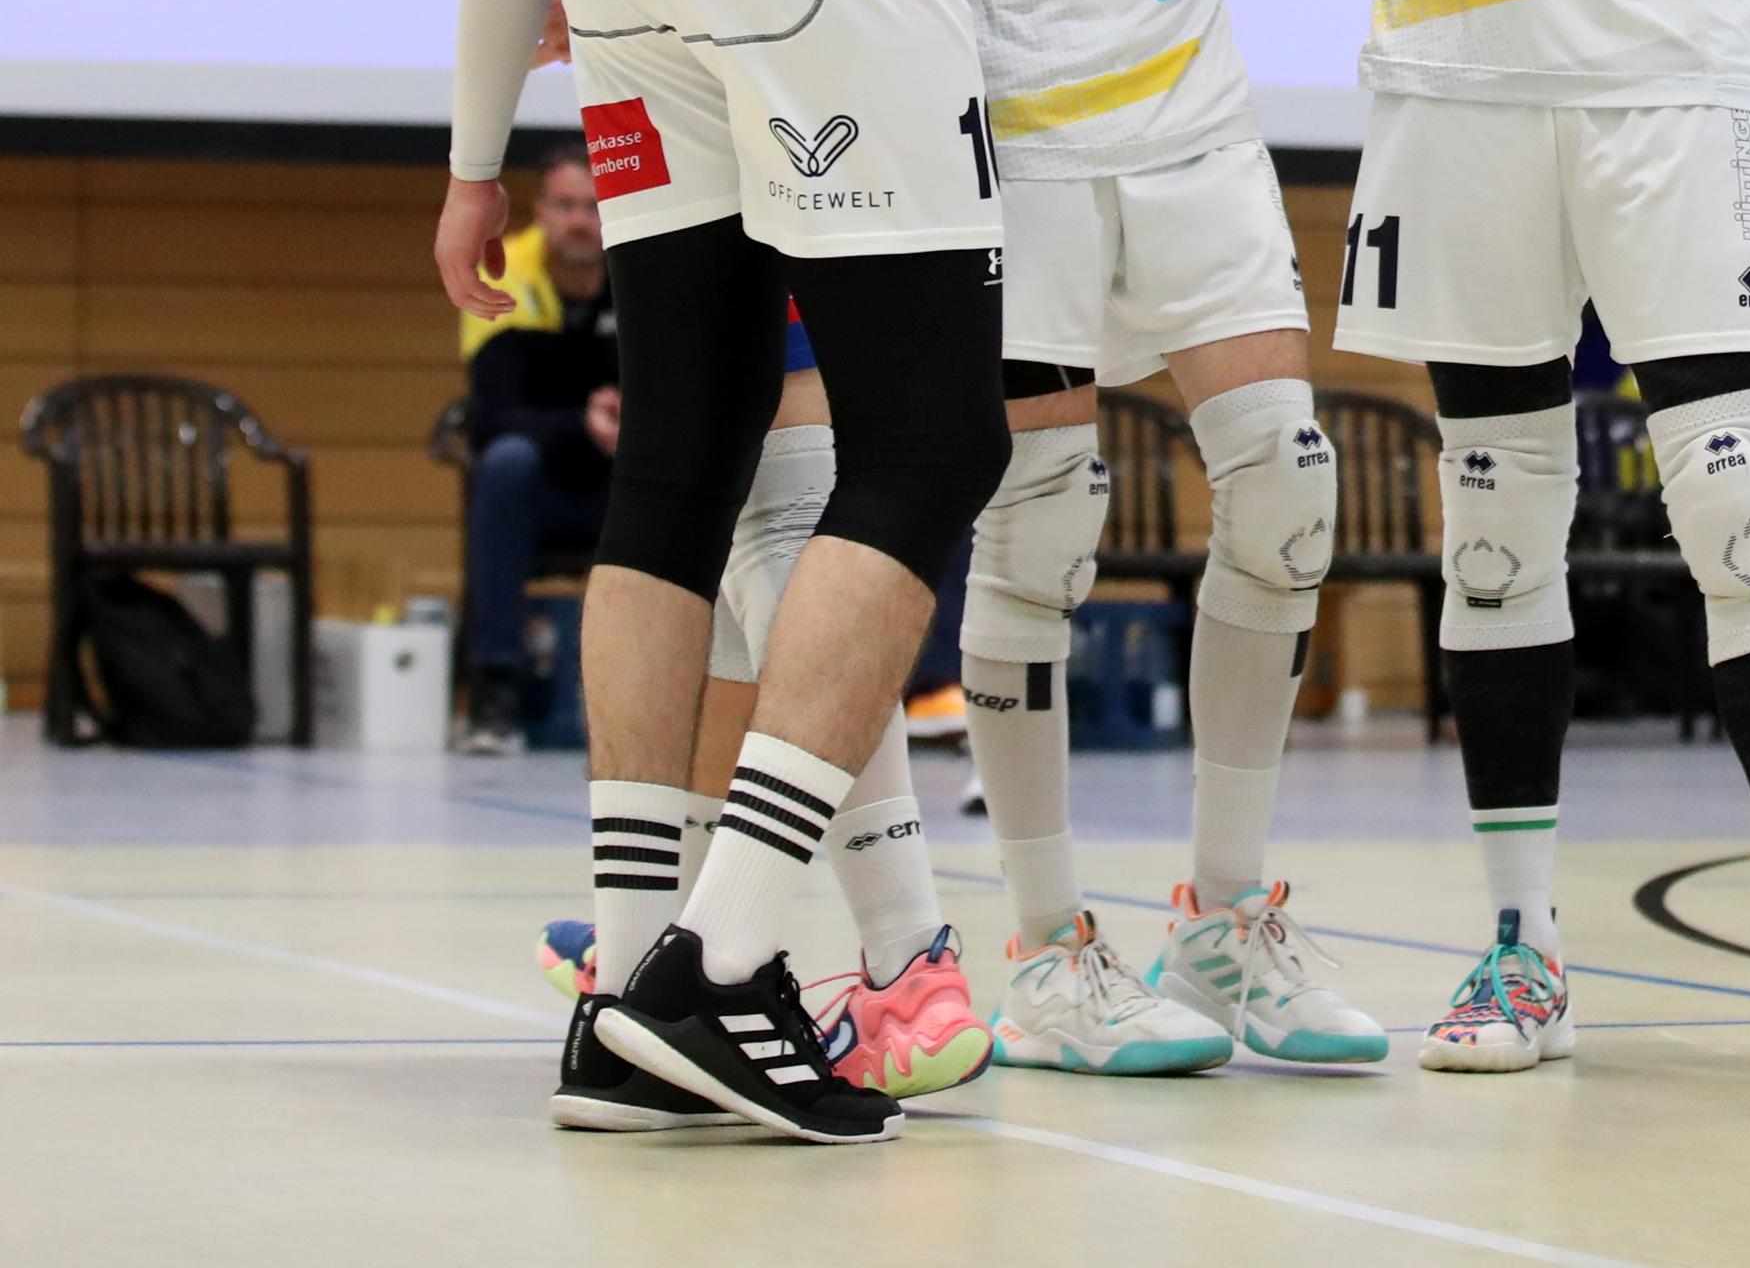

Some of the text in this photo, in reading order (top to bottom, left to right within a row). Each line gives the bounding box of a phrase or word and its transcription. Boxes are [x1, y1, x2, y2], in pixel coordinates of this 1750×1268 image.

[959, 94, 1001, 200] 1
[769, 180, 895, 210] OFFICEWELT
[1341, 213, 1400, 310] 11
[1297, 451, 1329, 468] errea
[1707, 453, 1747, 475] errea
[1460, 474, 1496, 491] errea
